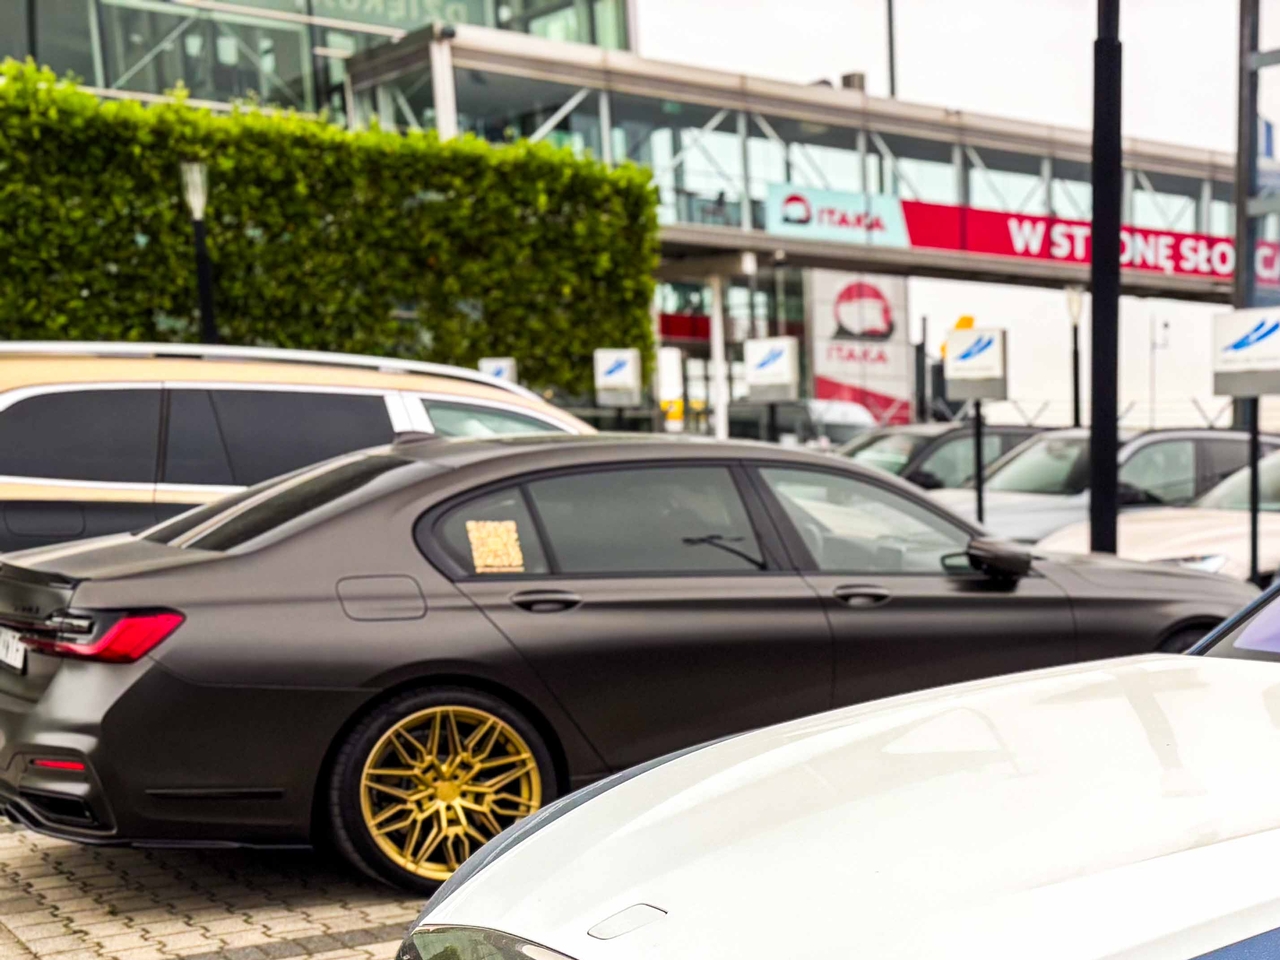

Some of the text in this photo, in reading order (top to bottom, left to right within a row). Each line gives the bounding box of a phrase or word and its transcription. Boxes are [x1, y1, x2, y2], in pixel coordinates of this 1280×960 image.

[817, 208, 885, 232] ITAKA
[1007, 217, 1046, 255] W
[1050, 224, 1175, 275] STONĘ
[826, 346, 887, 363] ITAKA
